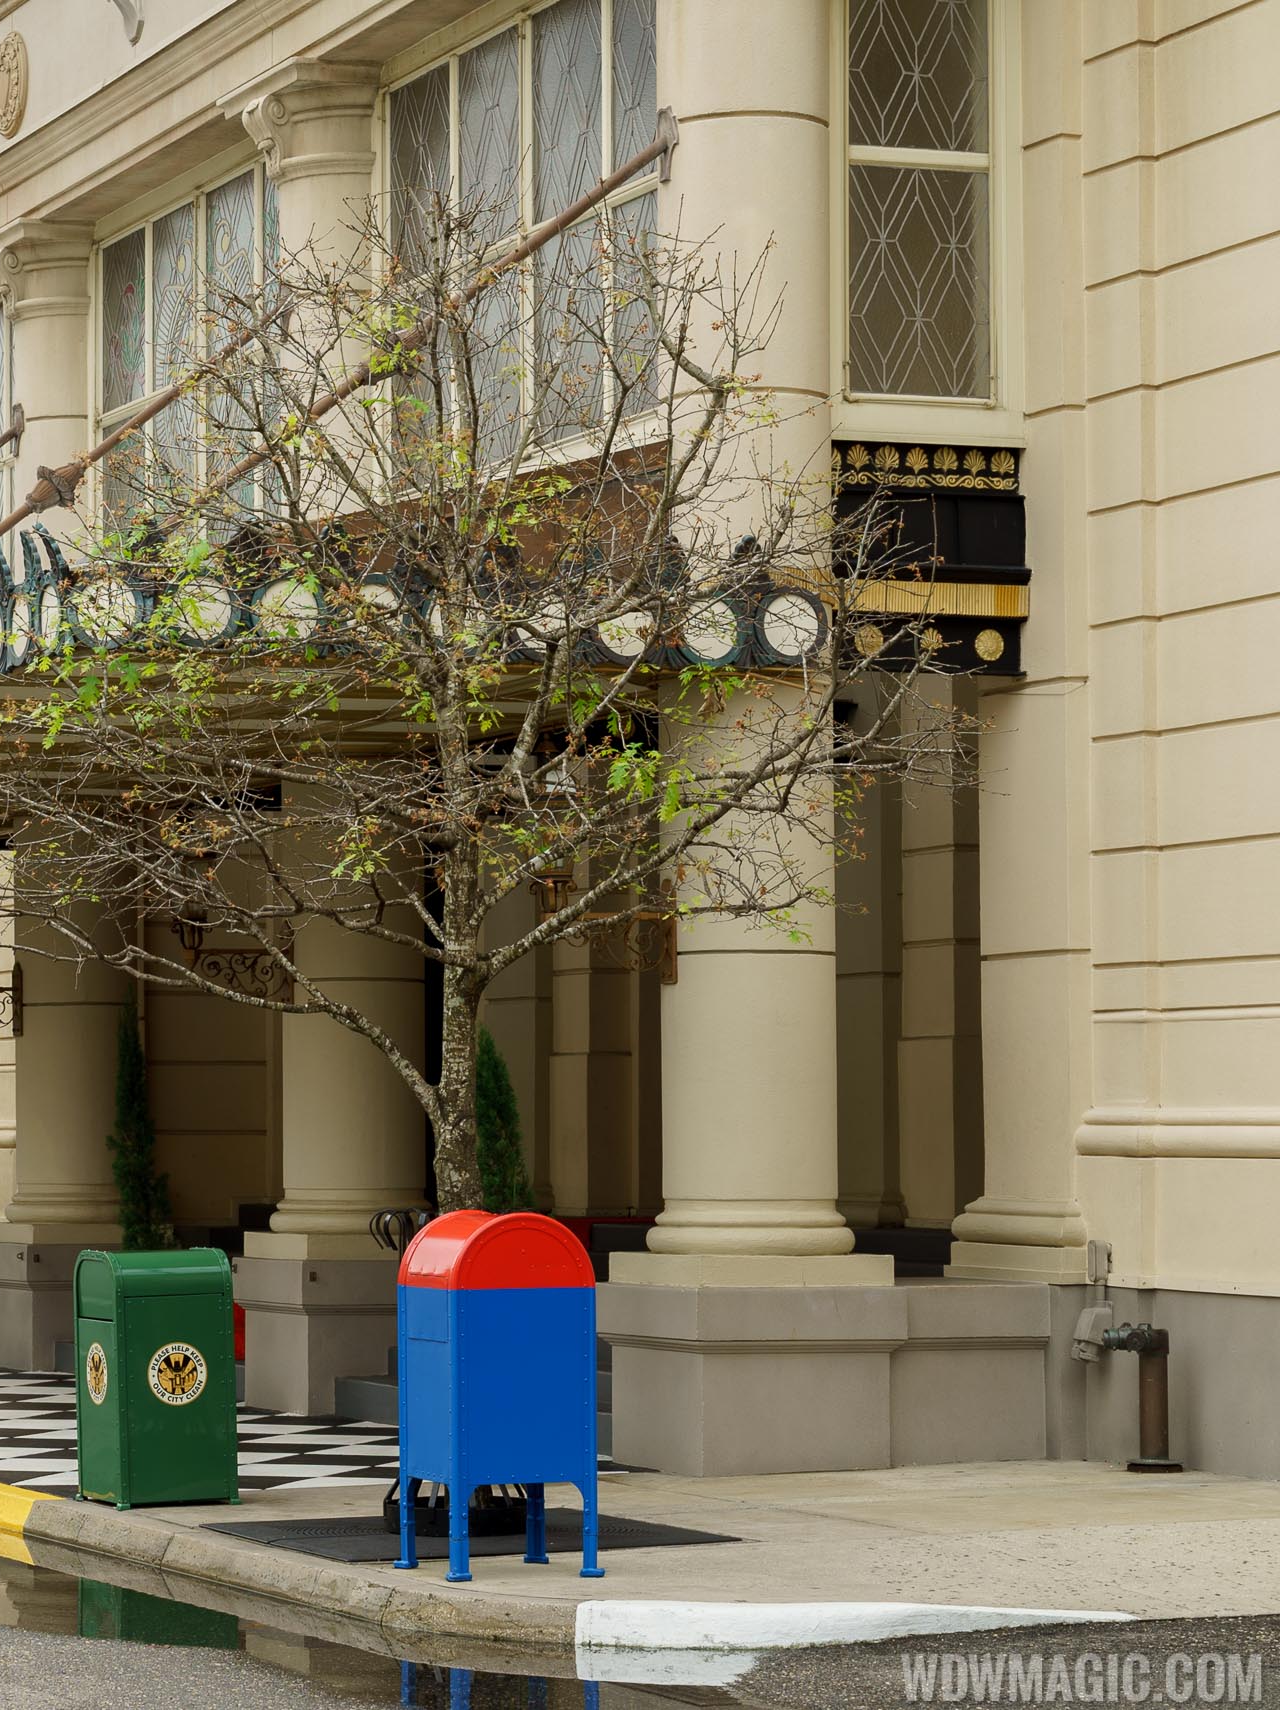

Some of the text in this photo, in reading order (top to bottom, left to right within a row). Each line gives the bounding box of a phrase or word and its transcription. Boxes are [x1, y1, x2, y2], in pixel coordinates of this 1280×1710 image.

[151, 1348, 170, 1371] PLEASE
[190, 1351, 204, 1368] KEEP
[153, 1383, 166, 1398] OUR
[185, 1380, 204, 1400] CLEAN
